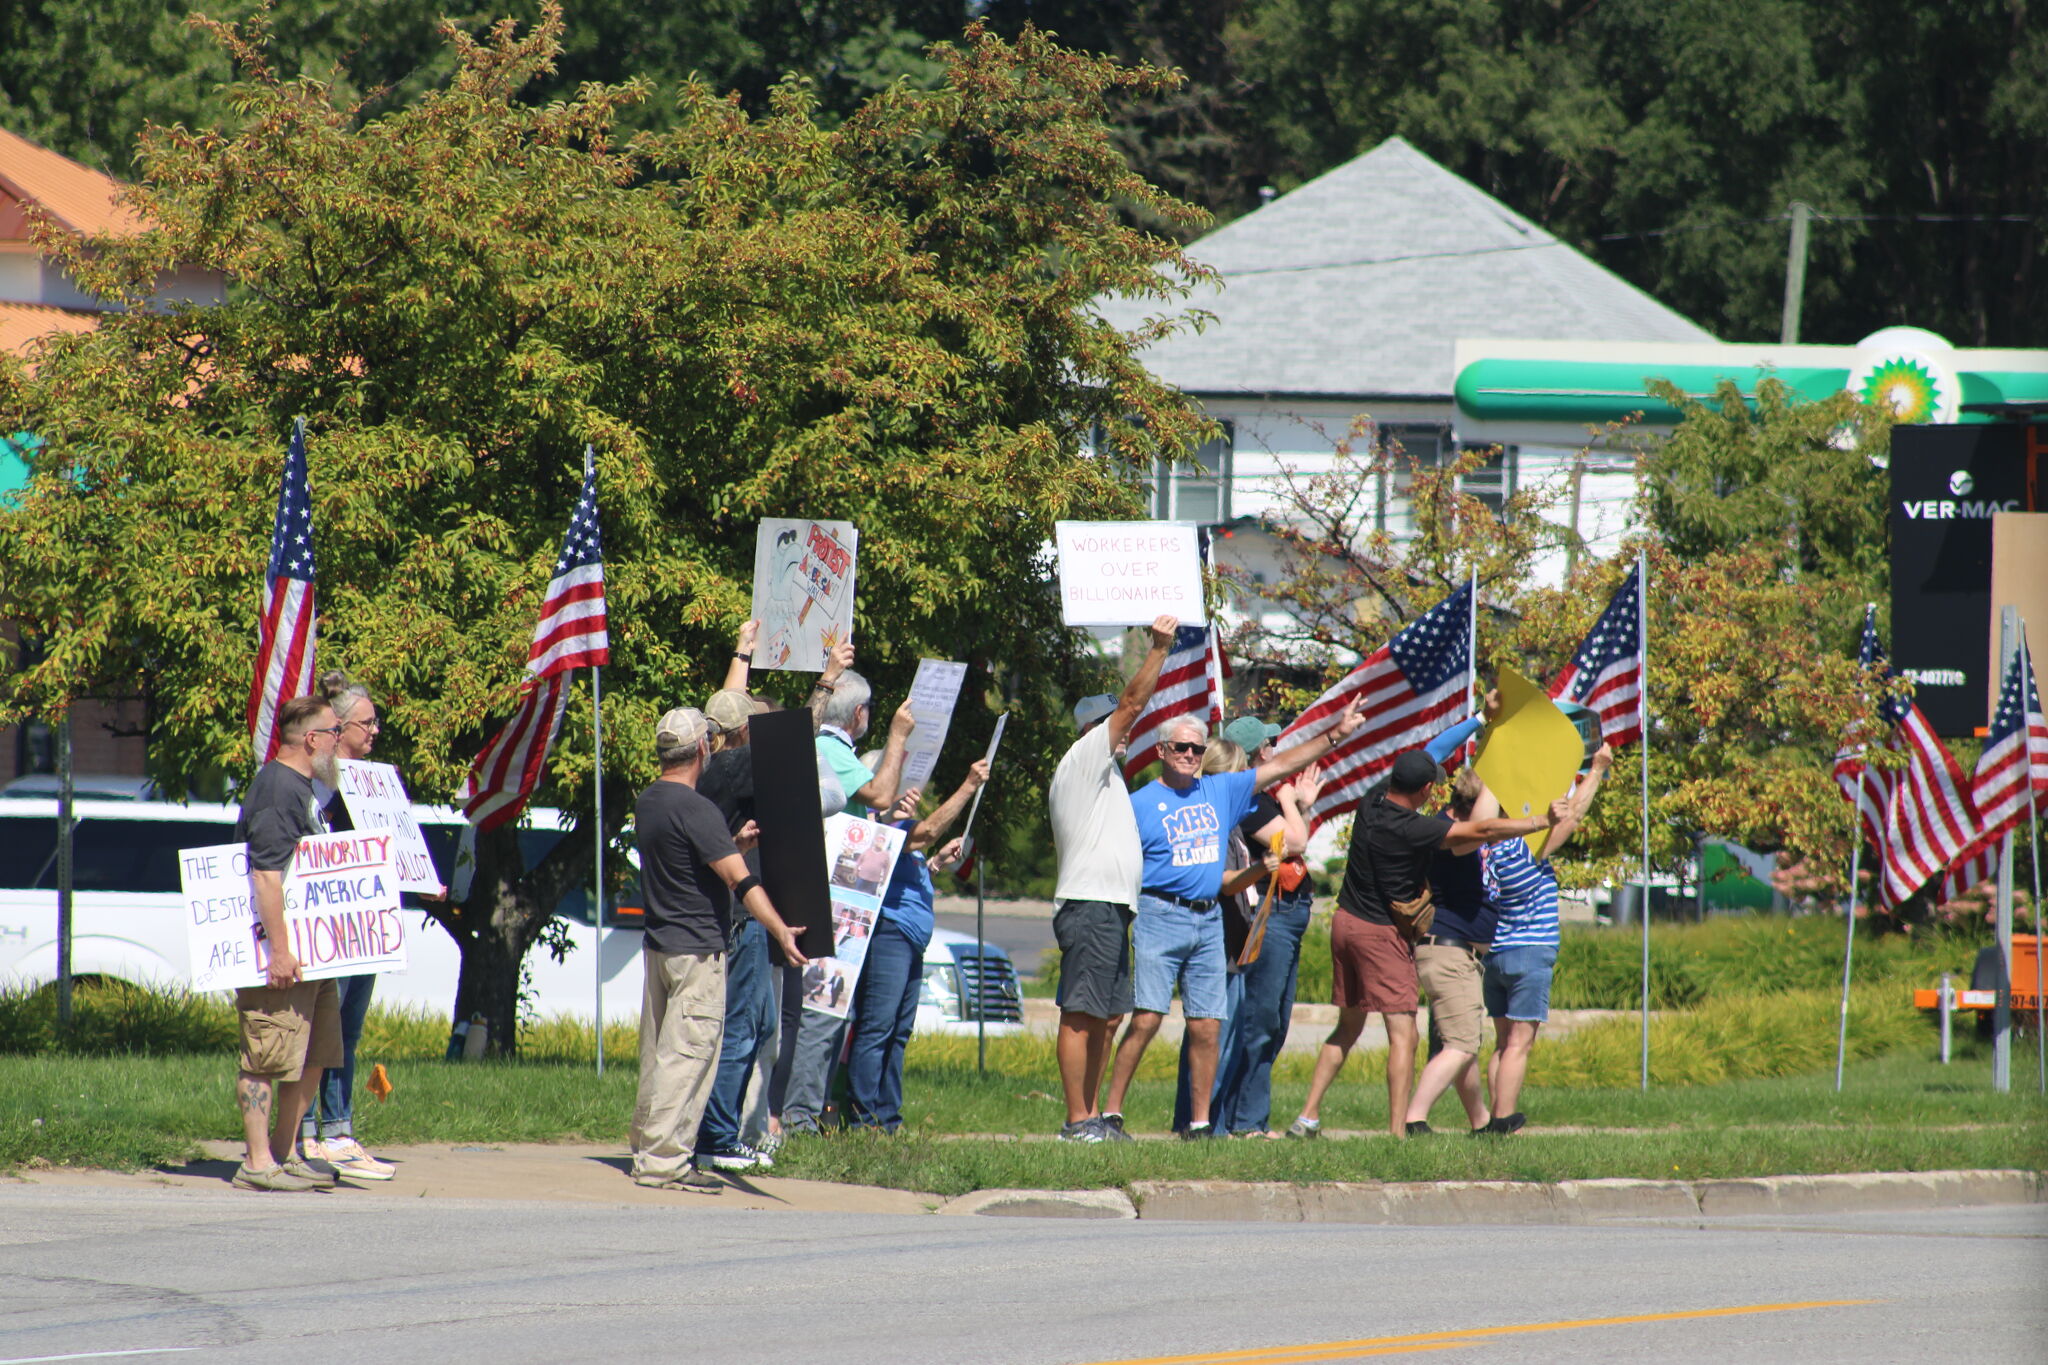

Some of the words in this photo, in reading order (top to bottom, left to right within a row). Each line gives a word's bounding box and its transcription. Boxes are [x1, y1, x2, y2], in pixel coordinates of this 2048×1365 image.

[1071, 537, 1181, 553] WORKERERS
[1100, 561, 1160, 577] OVER
[1069, 585, 1184, 601] BILLIONAIRES
[348, 765, 391, 800] PUNCH
[387, 769, 401, 800] A
[393, 810, 417, 840] AND
[183, 856, 220, 881] THE
[295, 835, 391, 872] MINORITY
[304, 874, 386, 910] AMERICA
[208, 940, 248, 968] ARE
